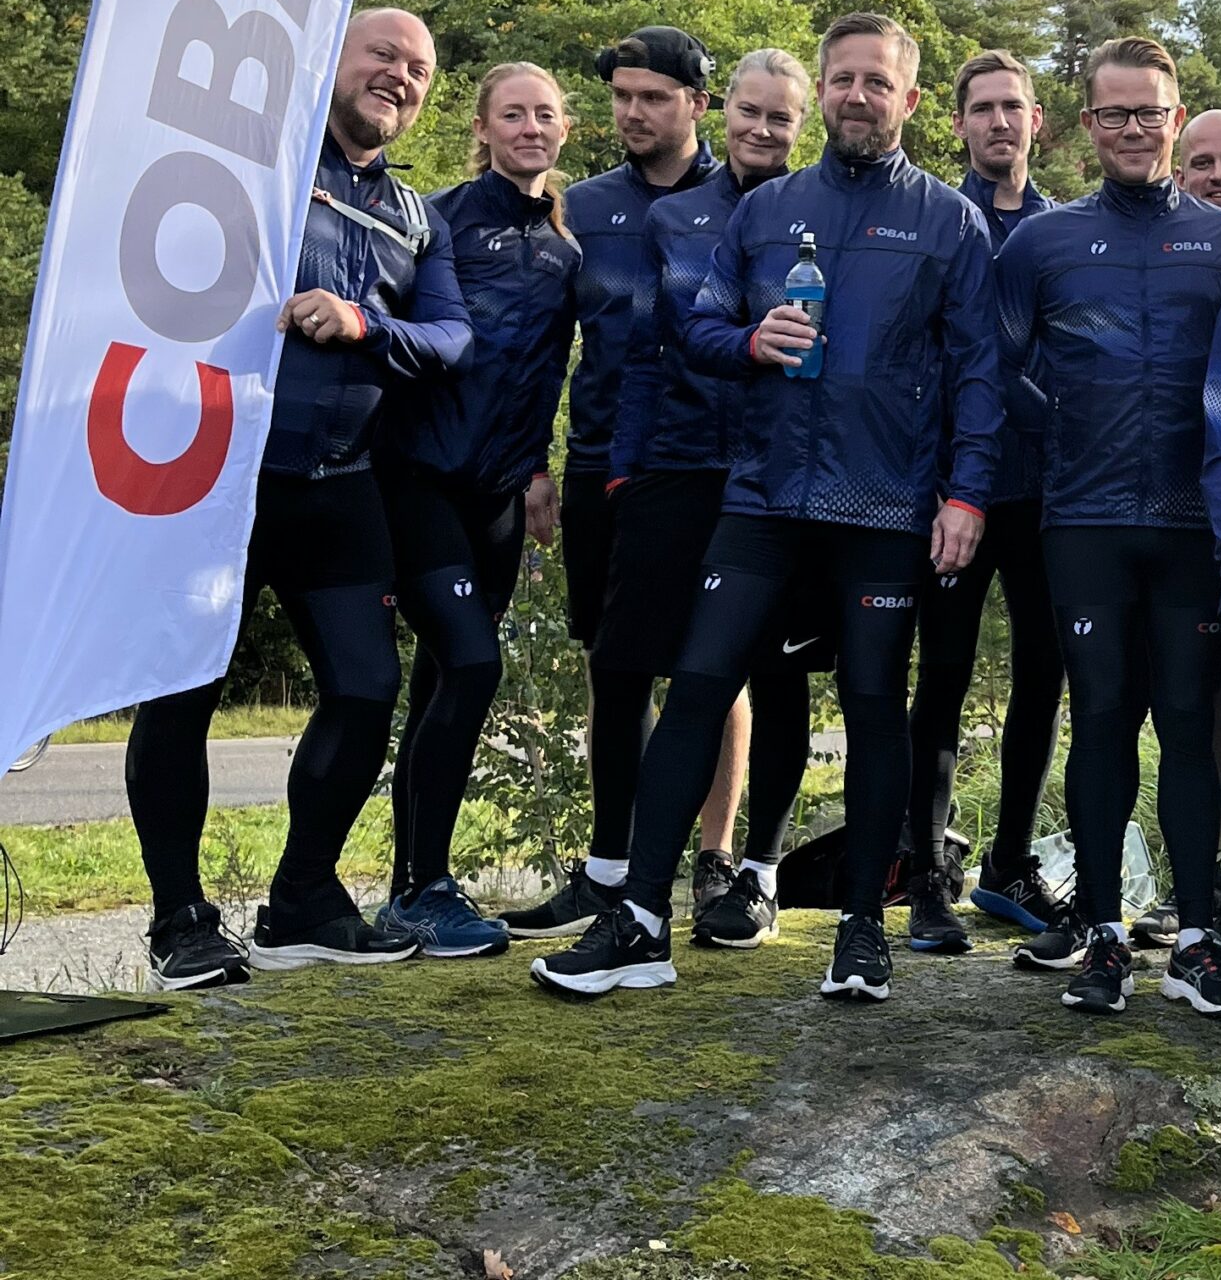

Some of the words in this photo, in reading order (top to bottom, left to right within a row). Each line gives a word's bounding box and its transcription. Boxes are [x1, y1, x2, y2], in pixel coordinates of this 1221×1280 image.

[867, 227, 918, 241] COBAB
[1162, 242, 1212, 252] COBAB
[861, 595, 914, 608] COBAB
